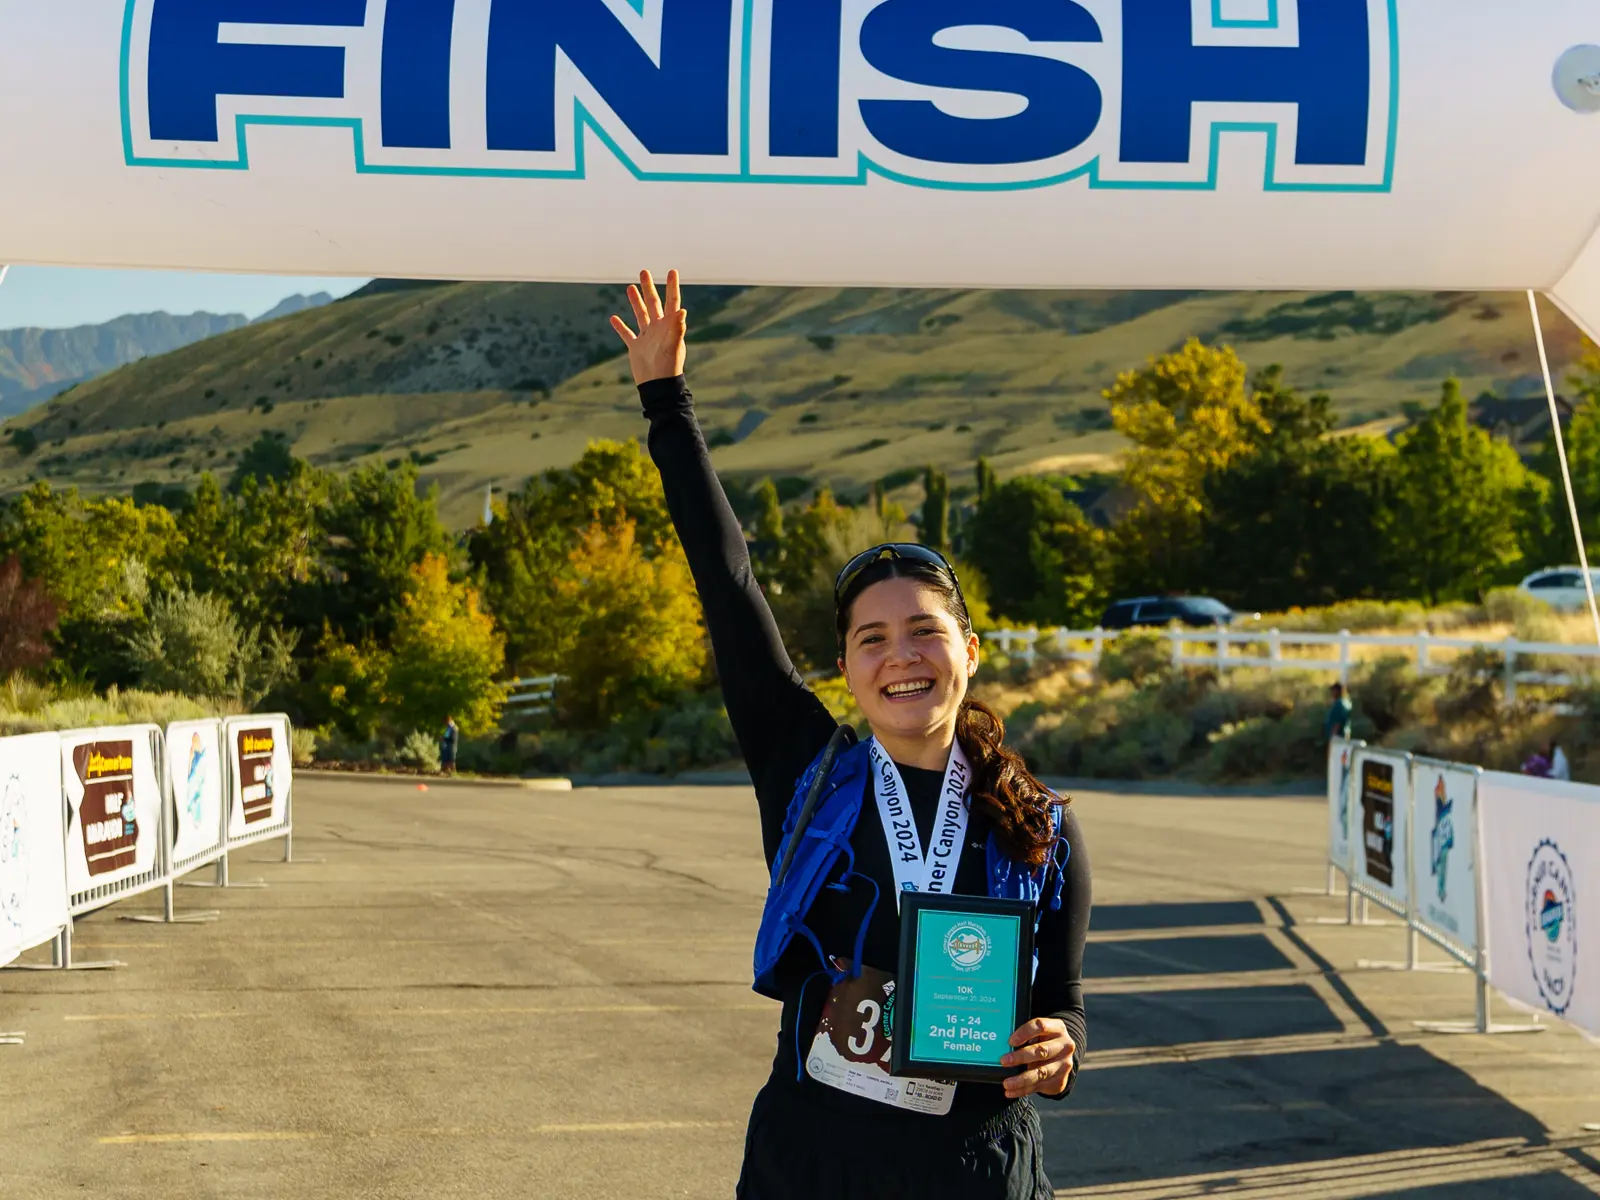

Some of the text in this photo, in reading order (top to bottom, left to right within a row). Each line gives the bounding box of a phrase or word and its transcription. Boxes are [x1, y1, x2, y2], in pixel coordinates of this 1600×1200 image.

[146, 0, 1370, 166] FINISH
[946, 759, 967, 800] 2024
[880, 760, 903, 817] Canyon
[892, 819, 919, 863] 2024
[932, 800, 962, 858] Canyon
[933, 992, 968, 1001] September
[980, 995, 997, 1003] 2024
[957, 985, 973, 994] 10K
[883, 1011, 891, 1037] Corner
[946, 1014, 958, 1024] 16
[967, 1016, 981, 1025] 24
[929, 1025, 997, 1041] 2nd Place
[943, 1040, 982, 1052] Female
